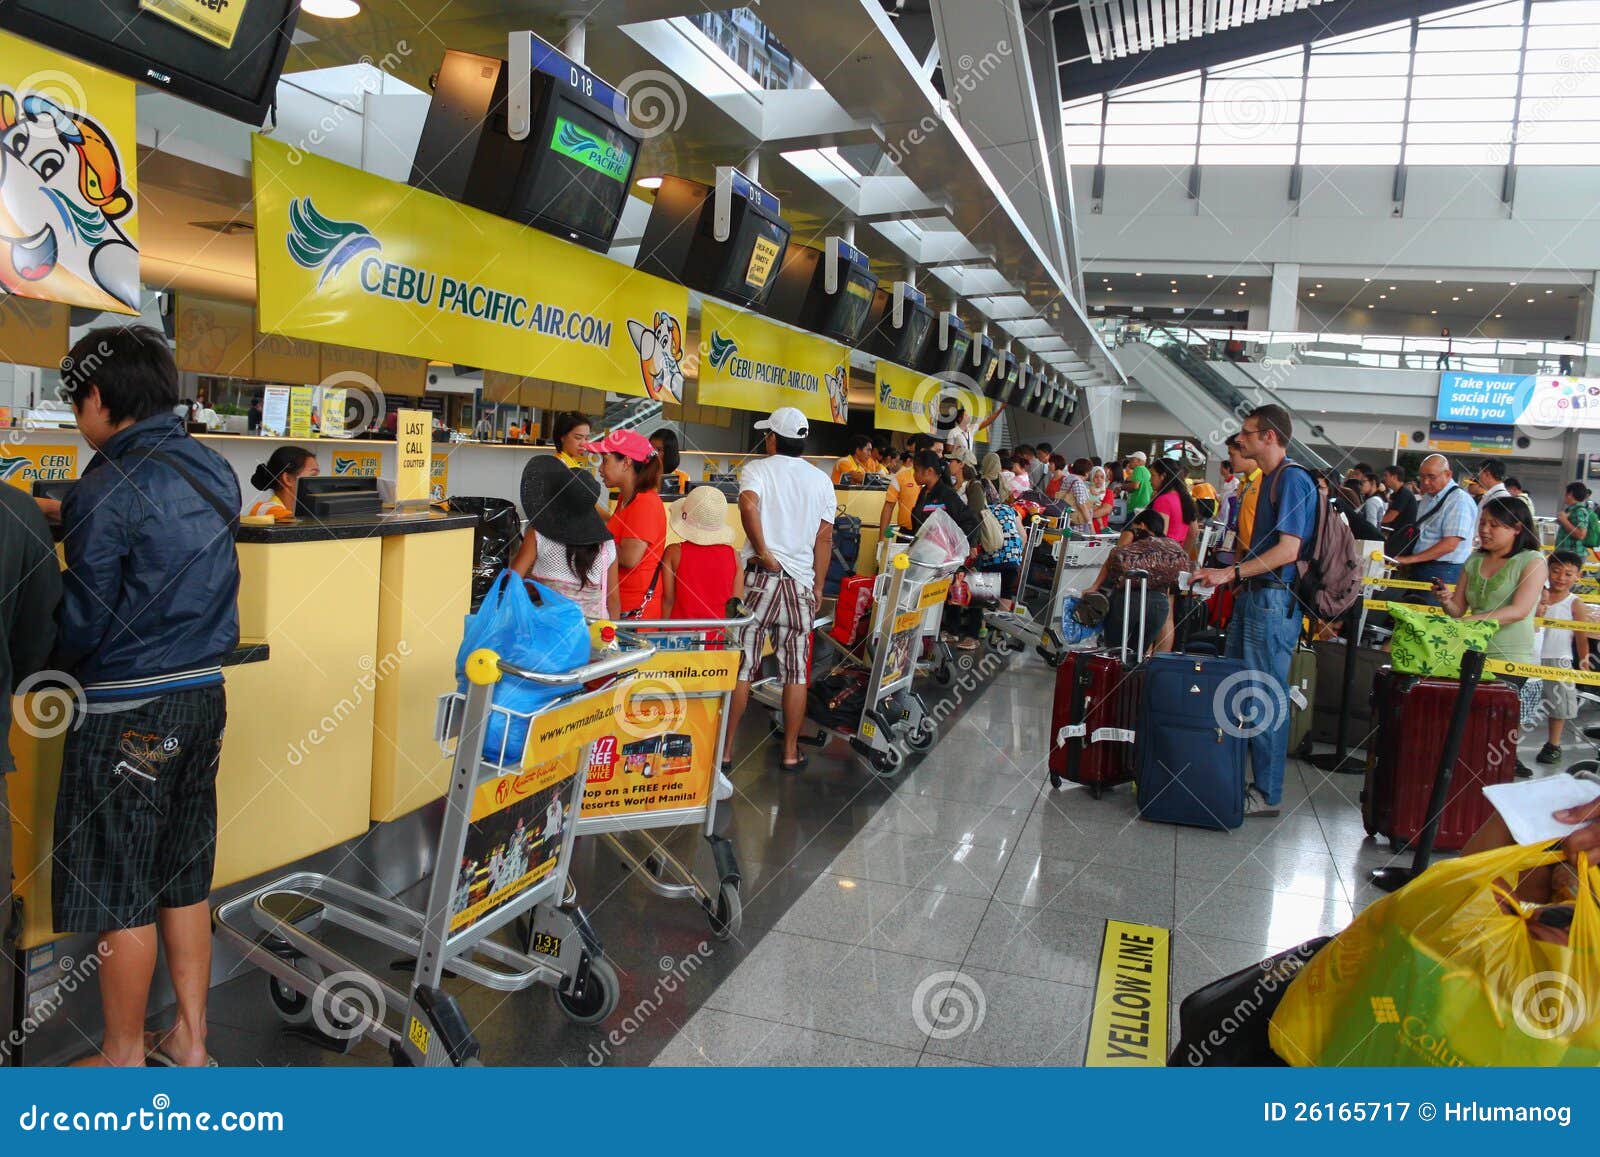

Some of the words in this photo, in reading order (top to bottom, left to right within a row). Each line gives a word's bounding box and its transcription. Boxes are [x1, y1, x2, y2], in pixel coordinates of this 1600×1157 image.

[570, 67, 578, 87] D
[581, 75, 592, 96] 18
[589, 151, 624, 176] PACIFIC
[360, 257, 435, 305] CEBU
[438, 277, 528, 327] PACIFIC
[528, 302, 613, 347] AIR.COM
[730, 357, 754, 379] CEBU
[755, 363, 787, 386] PACIFIC
[788, 371, 819, 393] AIR.COM
[1454, 377, 1483, 390] Take
[1486, 381, 1516, 392] your
[1452, 392, 1489, 404] social
[1492, 394, 1514, 405] life
[1450, 405, 1478, 417] with
[1481, 408, 1506, 419] you
[405, 422, 424, 435] LAST
[405, 442, 424, 454] CALL
[40, 455, 74, 467] CEBU
[403, 459, 425, 468] COUNTER
[22, 468, 72, 480] PACIFIC
[633, 666, 728, 680] .rwmanila.com
[1518, 665, 1553, 676] MALAYAN
[539, 702, 622, 743] www.rwmanila.com
[604, 789, 619, 797] on
[622, 787, 630, 795] a
[632, 782, 659, 793] FREE
[661, 781, 684, 791] ride
[624, 796, 656, 807] World
[658, 791, 697, 803] Manila!
[536, 933, 559, 949] 131
[1116, 932, 1154, 973] LINE
[1106, 973, 1152, 1060] YELLOW
[413, 1020, 428, 1043] 131
